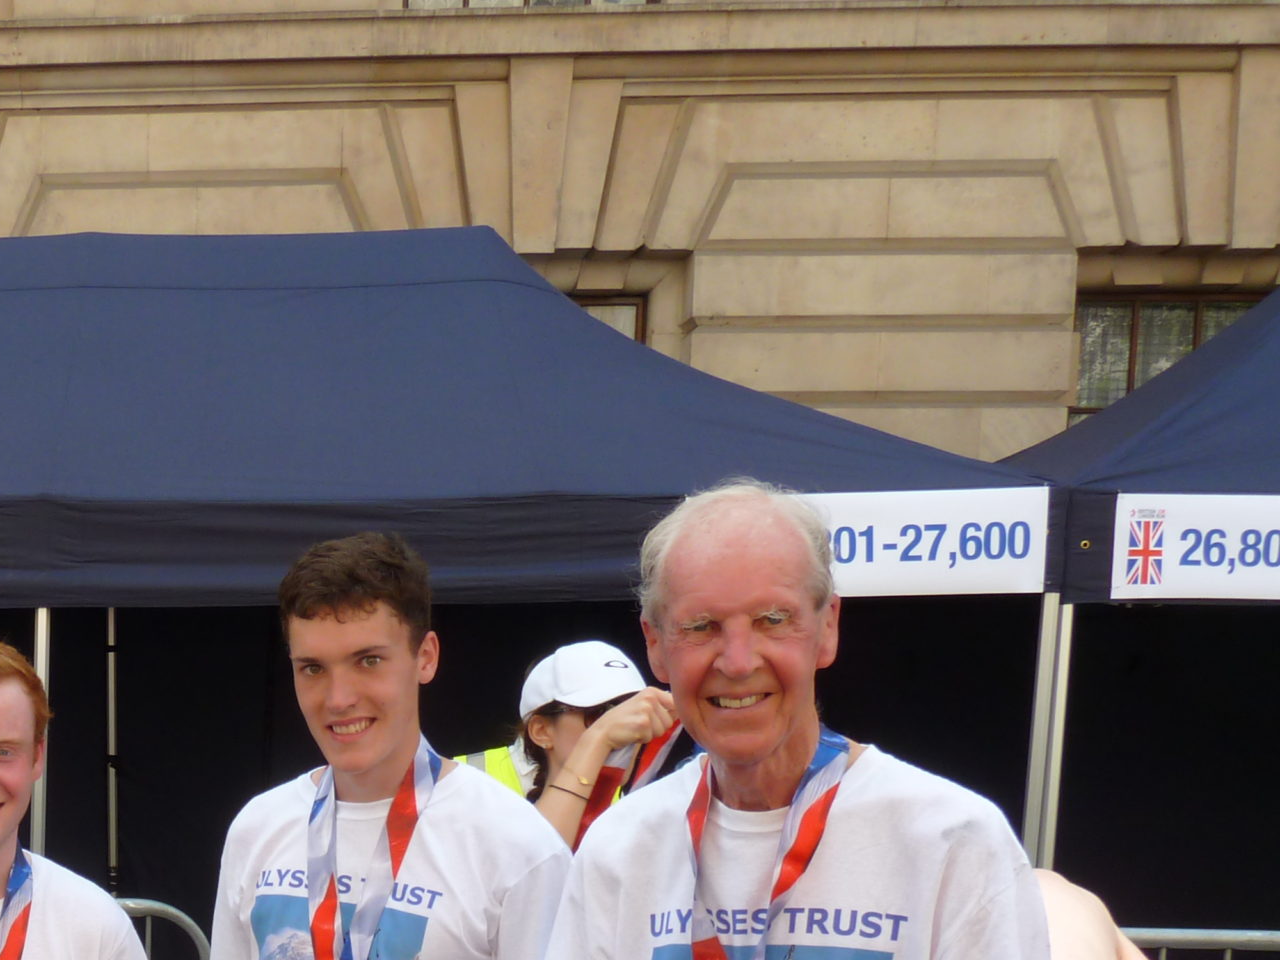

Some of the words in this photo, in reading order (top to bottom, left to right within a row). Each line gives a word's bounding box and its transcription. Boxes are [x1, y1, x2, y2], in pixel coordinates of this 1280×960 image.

[829, 521, 1031, 568] 01-27,600
[650, 908, 769, 937] ULYSES
[784, 907, 908, 941] TRUST
